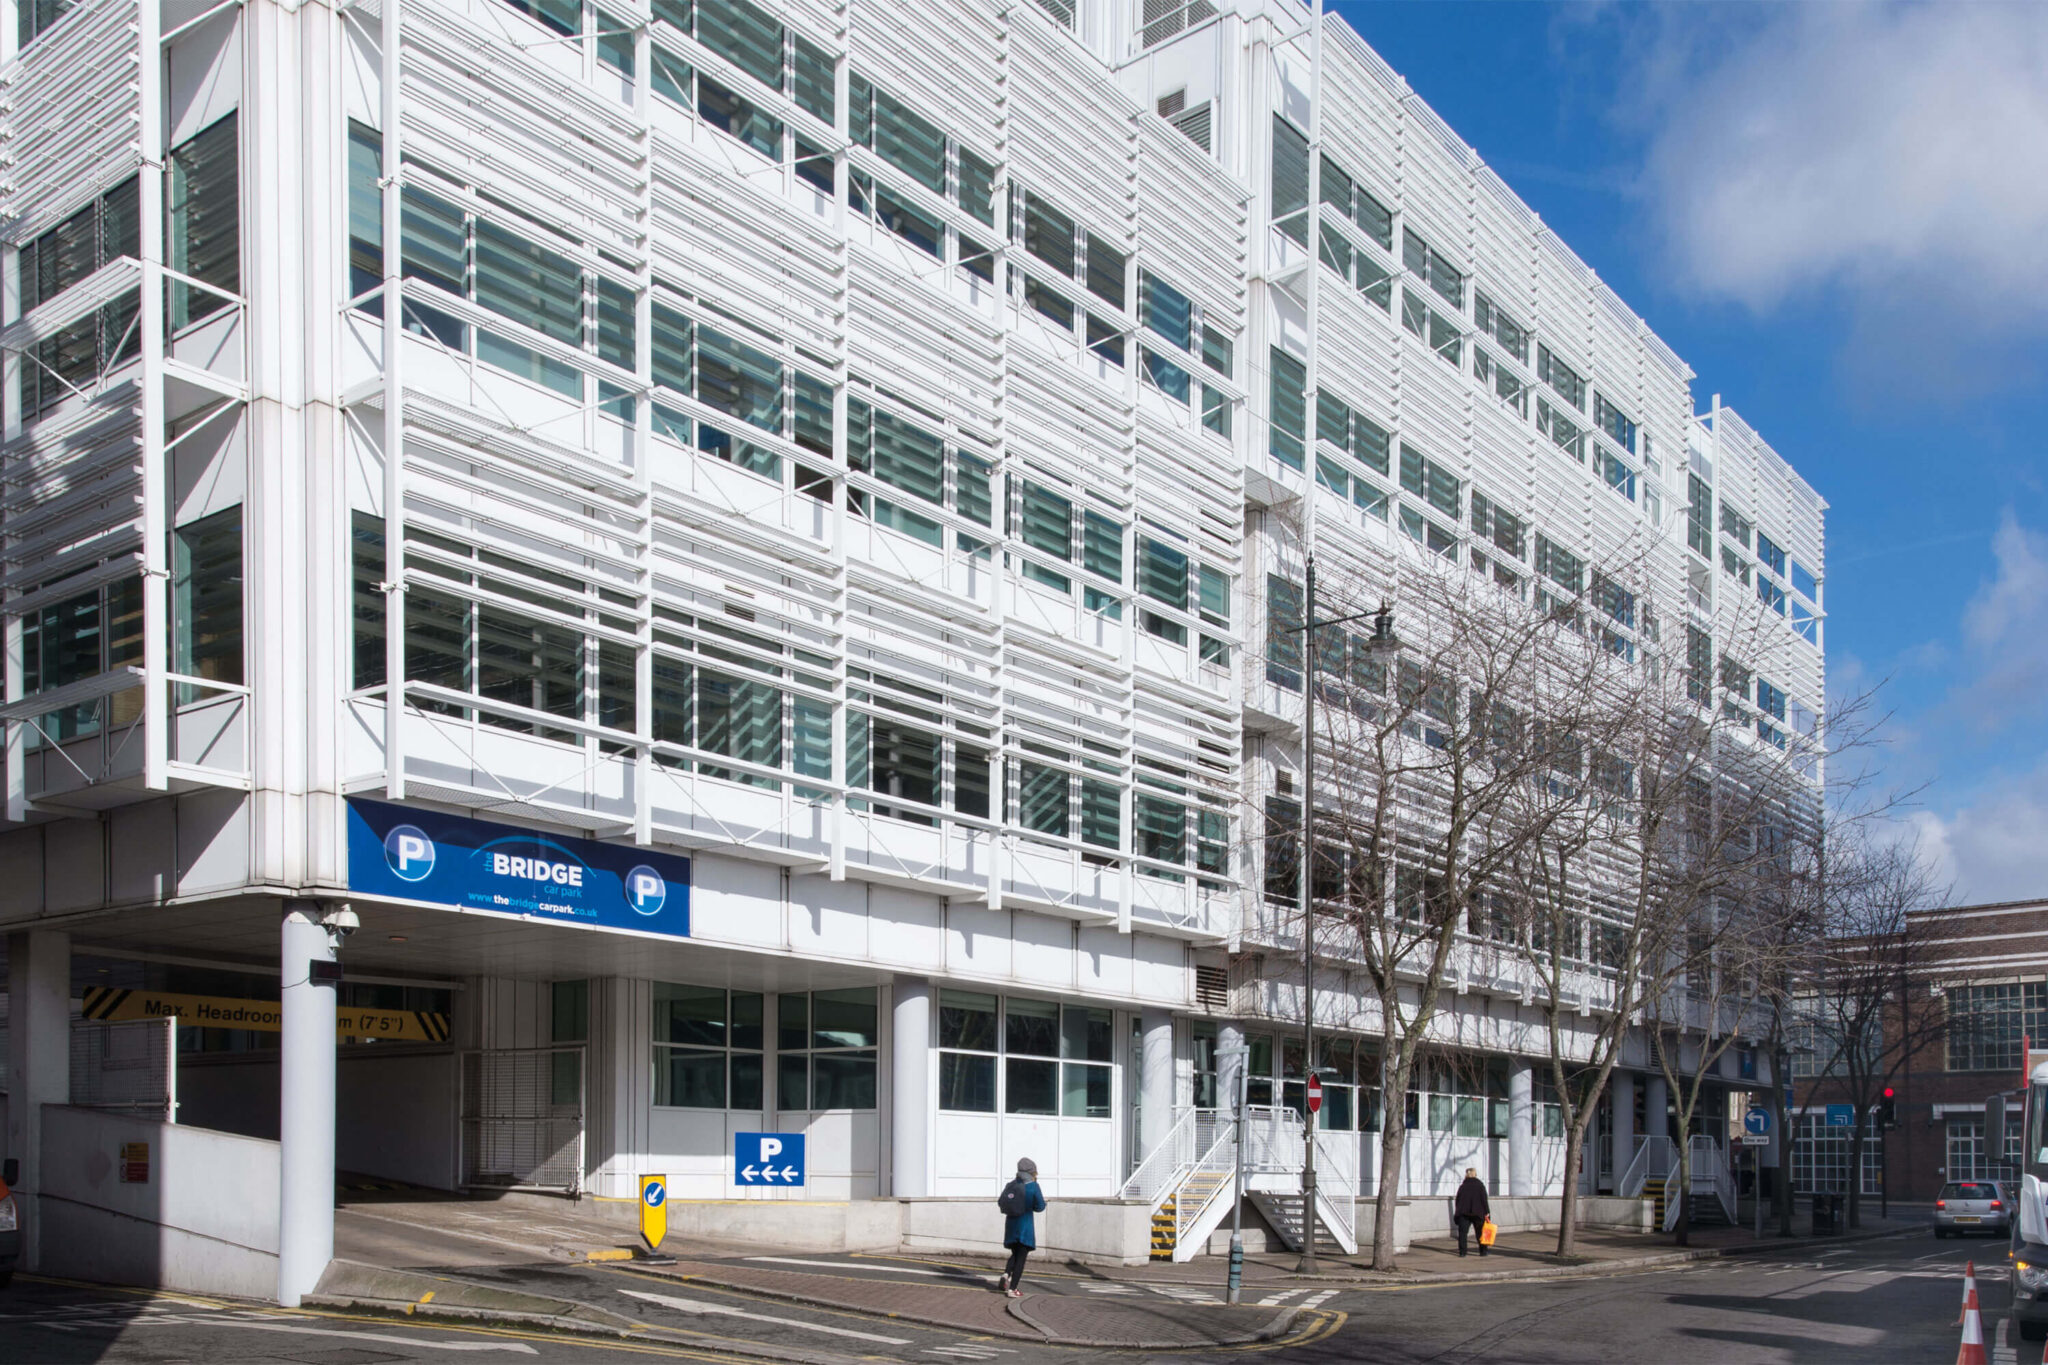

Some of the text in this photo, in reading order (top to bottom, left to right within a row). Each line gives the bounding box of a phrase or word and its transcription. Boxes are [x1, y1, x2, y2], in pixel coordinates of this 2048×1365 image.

[399, 834, 425, 870] P
[483, 852, 494, 872] the
[493, 852, 583, 887] BRIDGE
[543, 884, 583, 899] car park
[634, 874, 658, 906] P
[467, 892, 599, 917] www.thebridgecarpark.co.uk
[144, 999, 188, 1017] Max.
[760, 1137, 783, 1163] P
